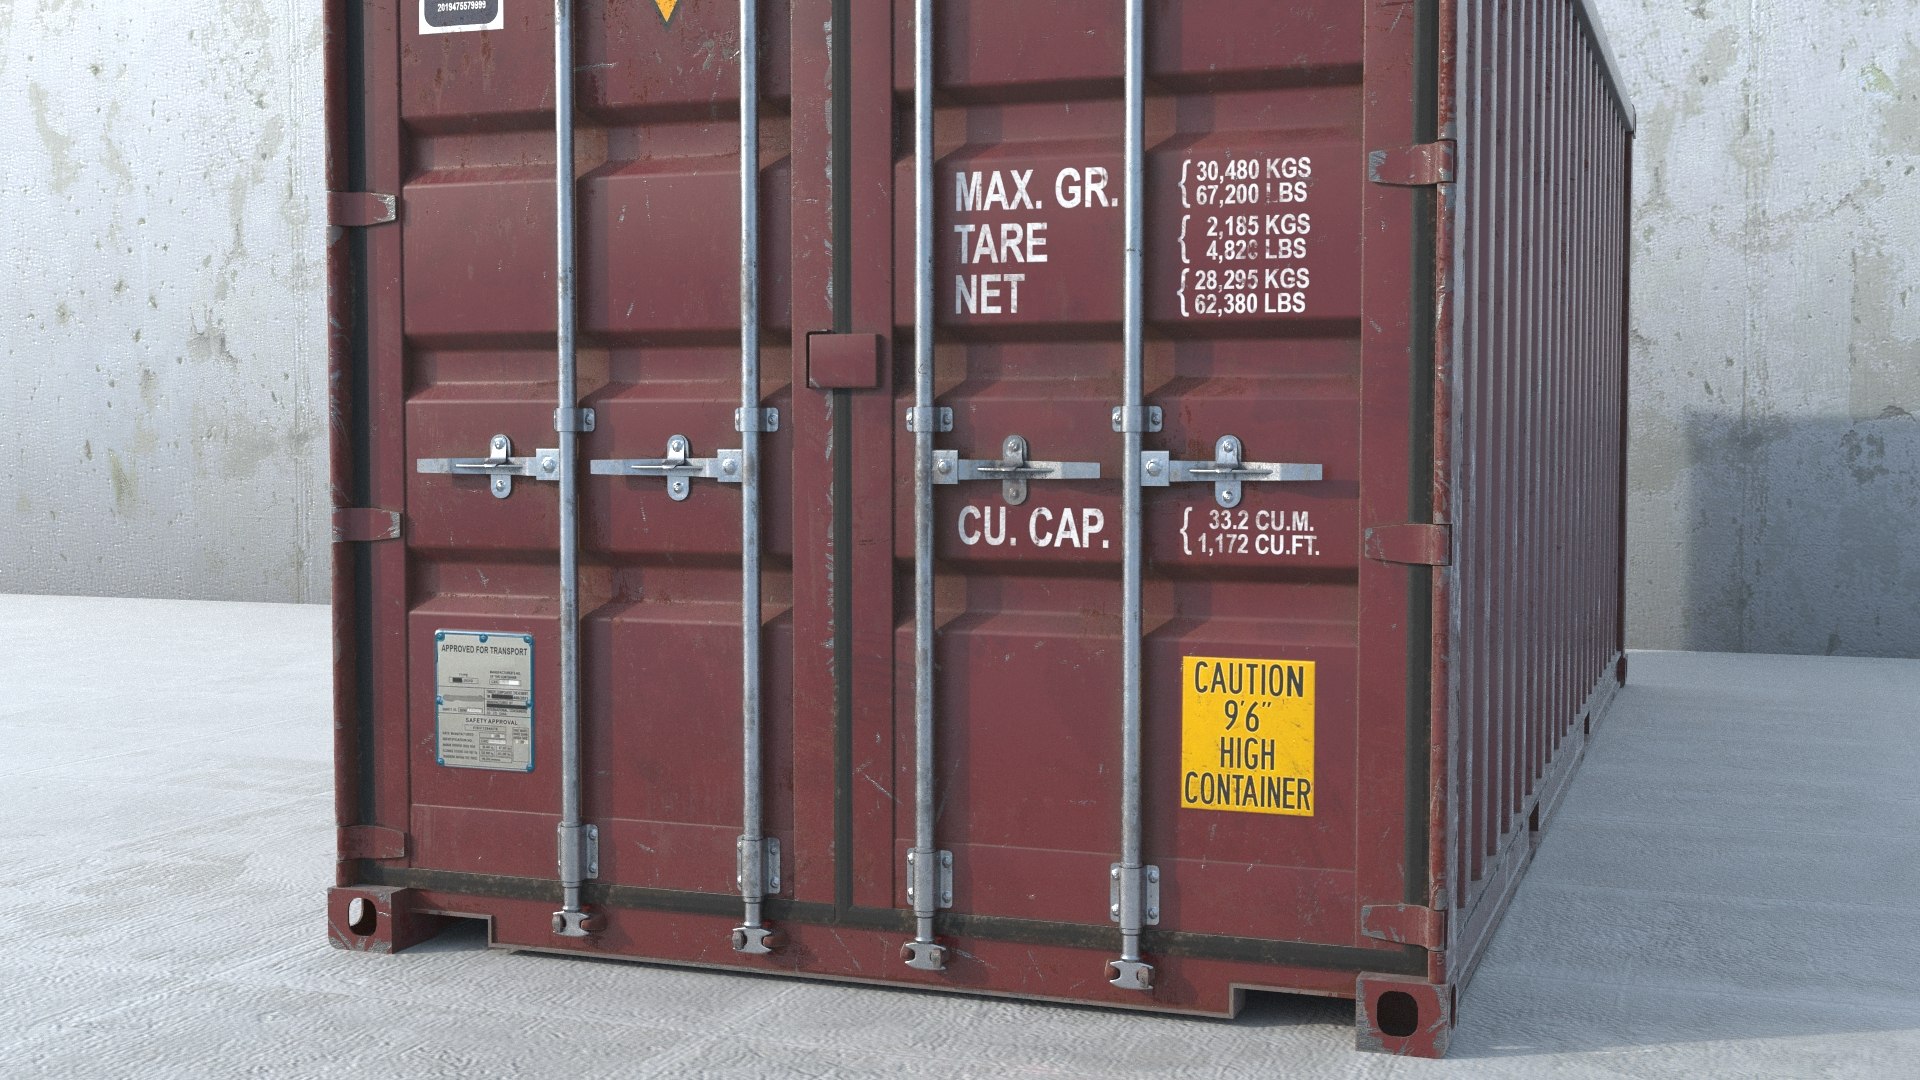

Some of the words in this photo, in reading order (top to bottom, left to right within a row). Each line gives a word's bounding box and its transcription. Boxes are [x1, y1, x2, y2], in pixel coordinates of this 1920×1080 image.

[1196, 159, 1260, 184] 30,480
[1266, 156, 1311, 179] KGS
[954, 169, 1043, 211] MAX.
[1054, 167, 1118, 208] GR.
[1196, 183, 1260, 208] 67,200
[1206, 215, 1259, 240] 2,185
[1265, 213, 1311, 235] KGS
[954, 222, 1048, 264] TARE
[1265, 237, 1307, 259] LBS
[1194, 269, 1259, 293] 28,295
[1264, 268, 1310, 289] KGS
[955, 274, 1025, 315] NET
[1194, 293, 1258, 317] 62,380
[1264, 291, 1306, 313] LBS
[958, 505, 1017, 546] CU.
[1028, 507, 1110, 549] CAP.
[1208, 509, 1249, 531] 33.2
[1255, 510, 1315, 532] CU.M.
[1197, 532, 1249, 557] 1,172
[1255, 533, 1320, 556] CU.FT.
[441, 644, 475, 654] APPROVED
[475, 646, 489, 654] FOR
[490, 646, 528, 656] TRANSPORT
[1194, 660, 1304, 698] CAUTION
[487, 718, 518, 726] APPROVAL
[1219, 736, 1275, 770] HIGH
[1184, 771, 1312, 811] CONTAINER
